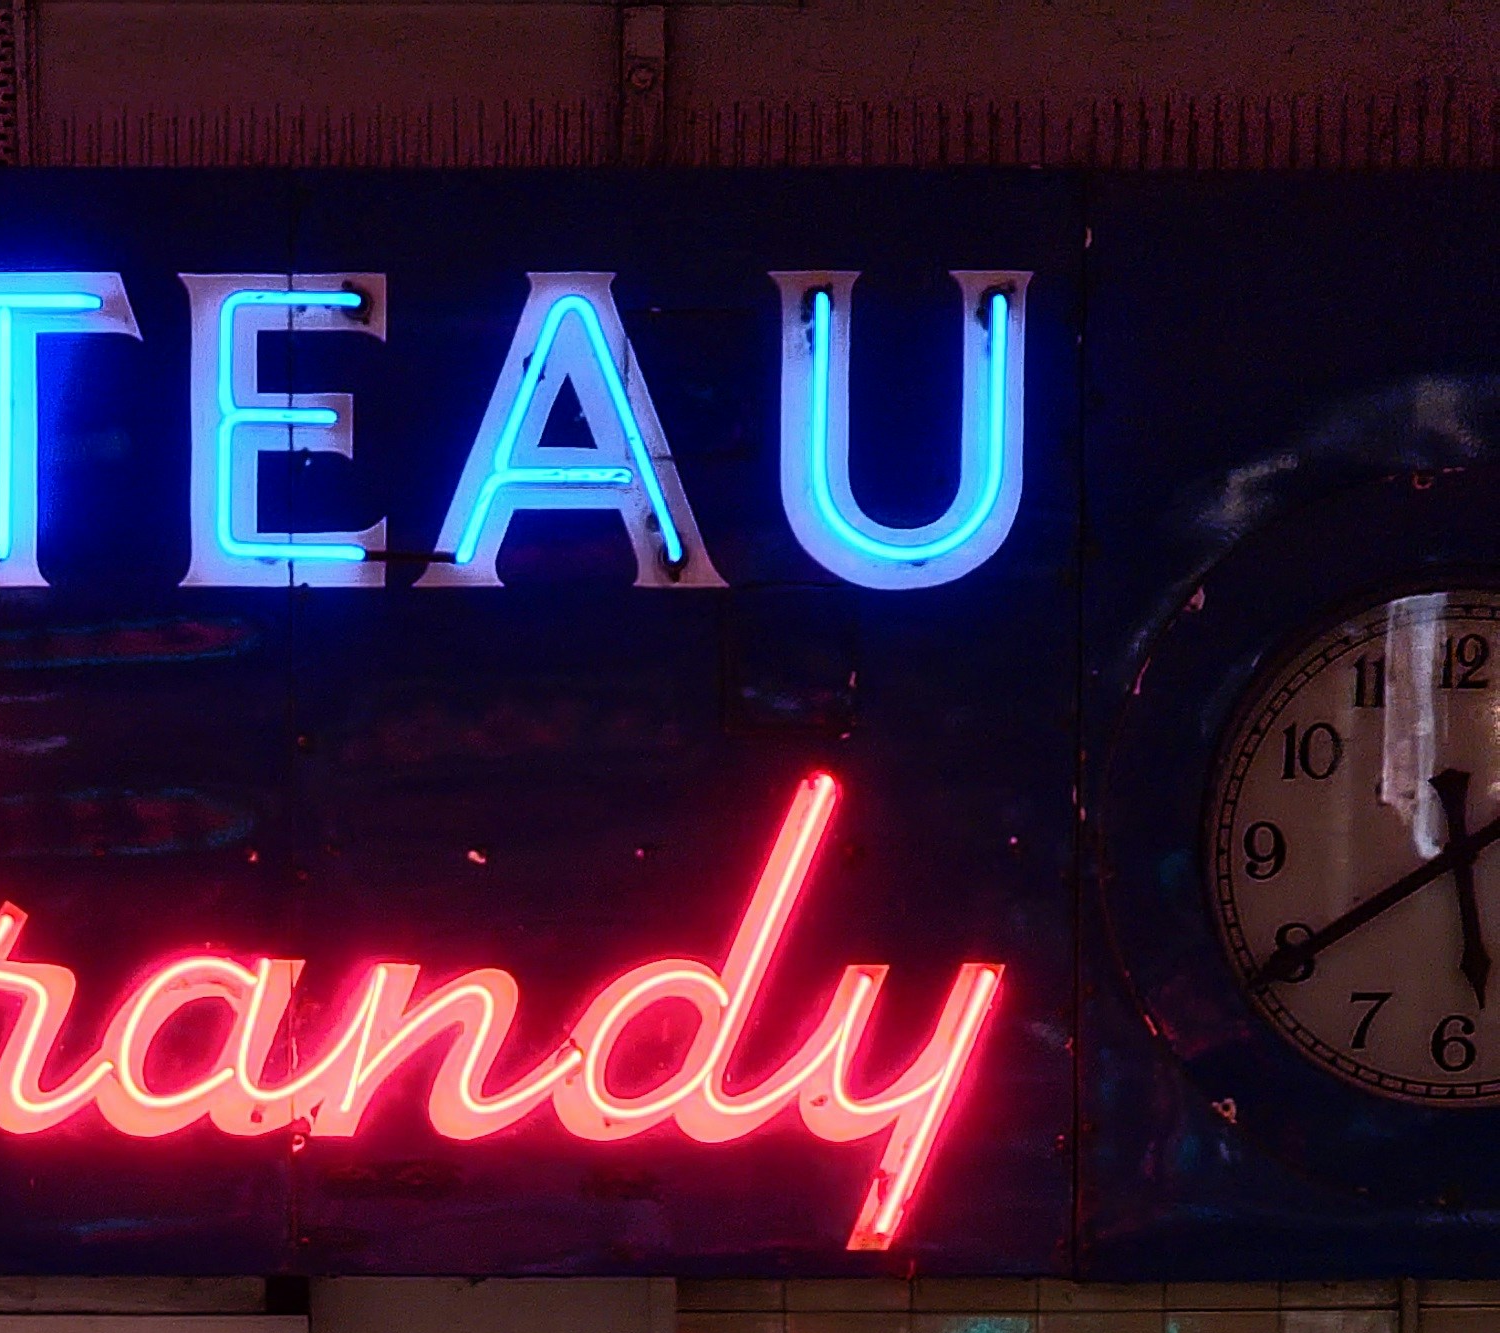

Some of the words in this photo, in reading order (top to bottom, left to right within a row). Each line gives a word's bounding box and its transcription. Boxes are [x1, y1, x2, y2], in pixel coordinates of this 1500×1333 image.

[1353, 654, 1386, 707] 11
[1436, 633, 1489, 689] 12
[1281, 722, 1343, 781] 10
[1243, 820, 1287, 881] 9
[1349, 992, 1393, 1050] 7
[1430, 1014, 1476, 1073] 6
